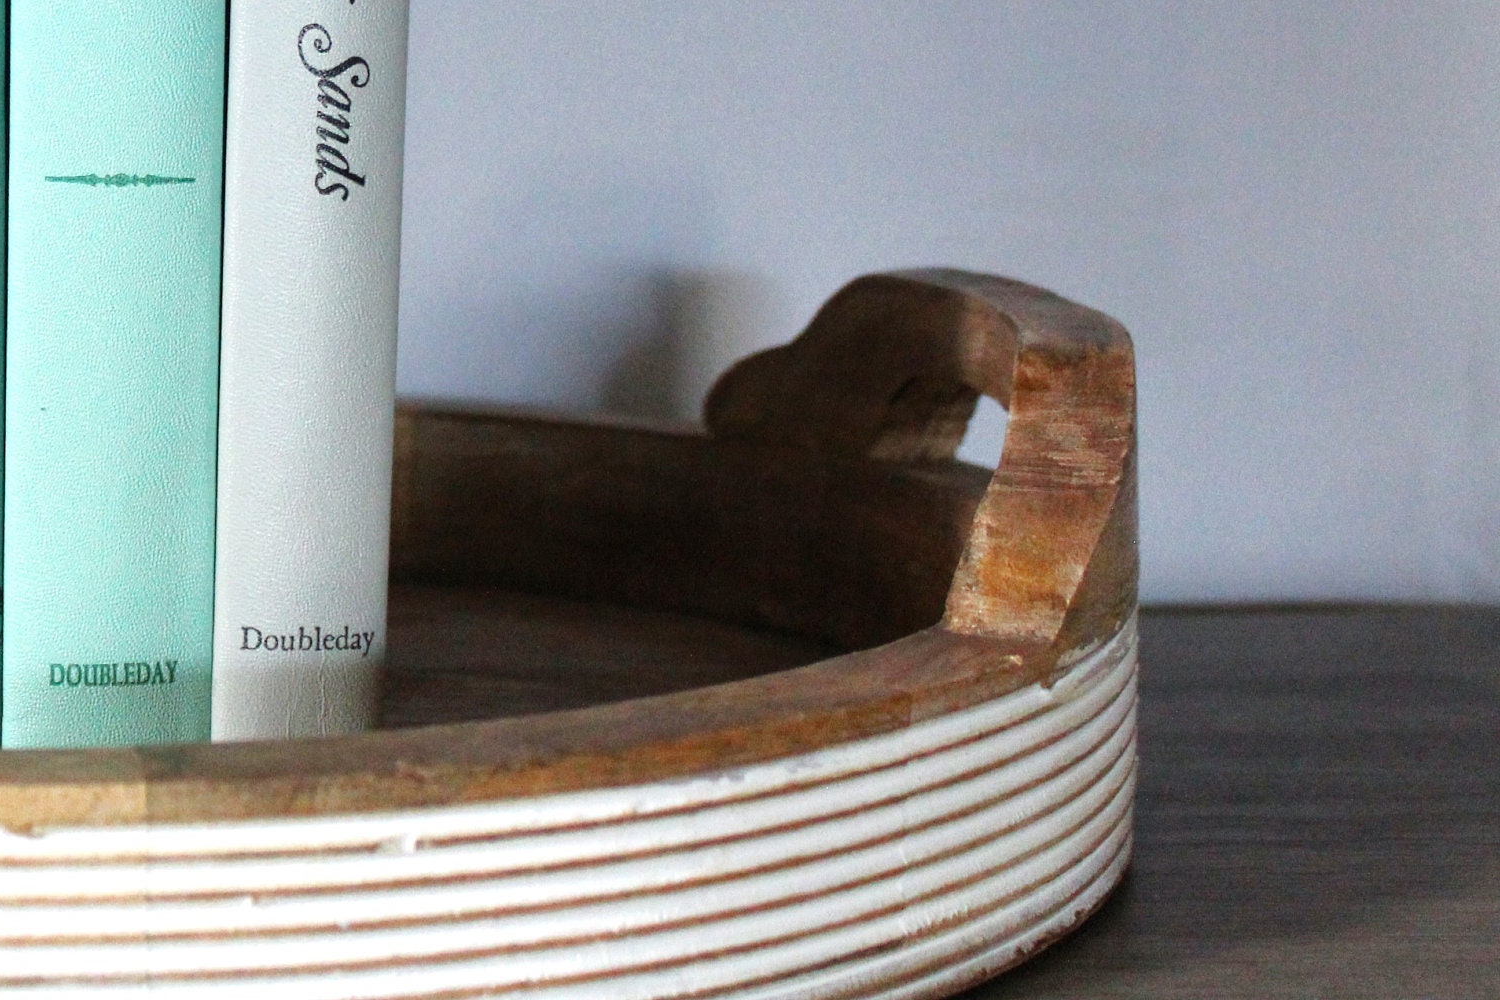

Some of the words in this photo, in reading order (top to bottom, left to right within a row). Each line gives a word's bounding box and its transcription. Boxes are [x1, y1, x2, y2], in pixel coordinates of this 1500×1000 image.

[297, 22, 371, 202] Sands
[241, 626, 375, 655] Doubleday
[49, 660, 178, 687] DOUBLEDAY
